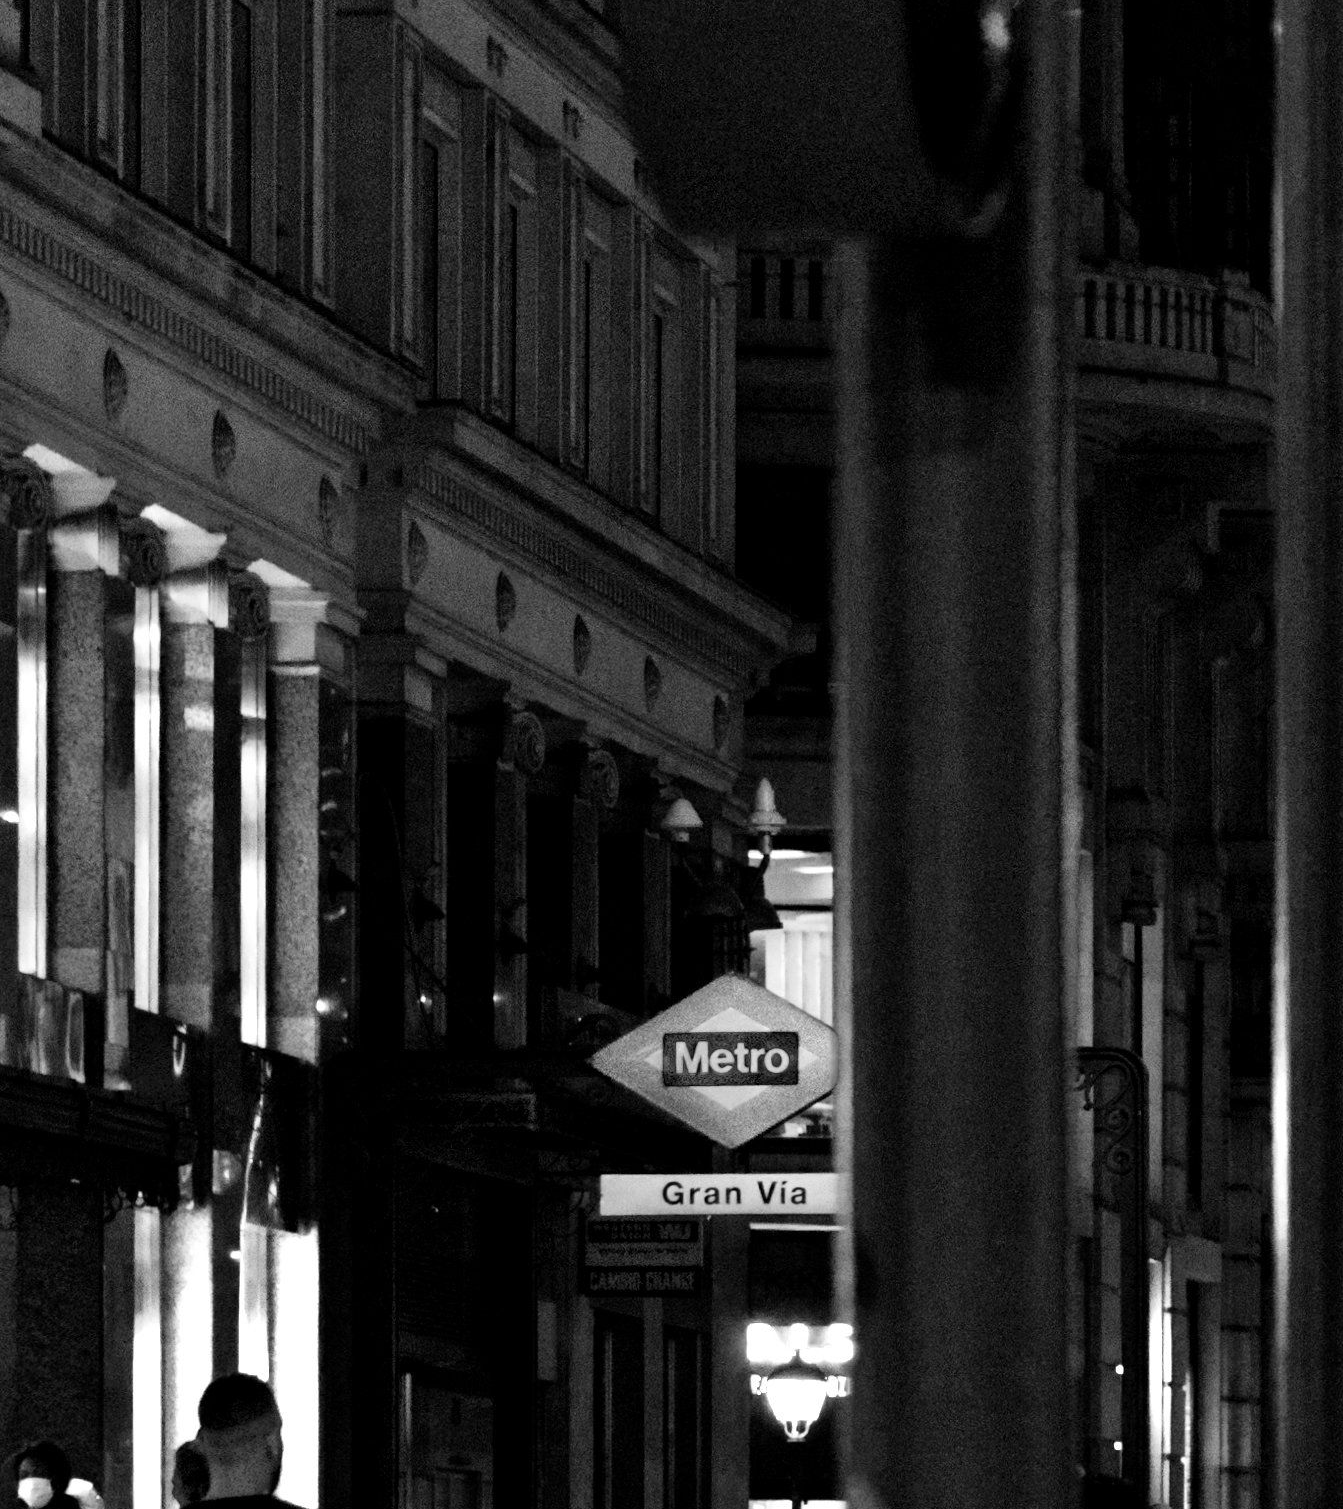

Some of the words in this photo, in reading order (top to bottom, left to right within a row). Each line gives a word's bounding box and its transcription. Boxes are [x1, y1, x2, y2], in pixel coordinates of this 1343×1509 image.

[674, 1040, 790, 1075] Metro
[661, 1180, 743, 1206] Gran
[756, 1180, 808, 1205] Vía
